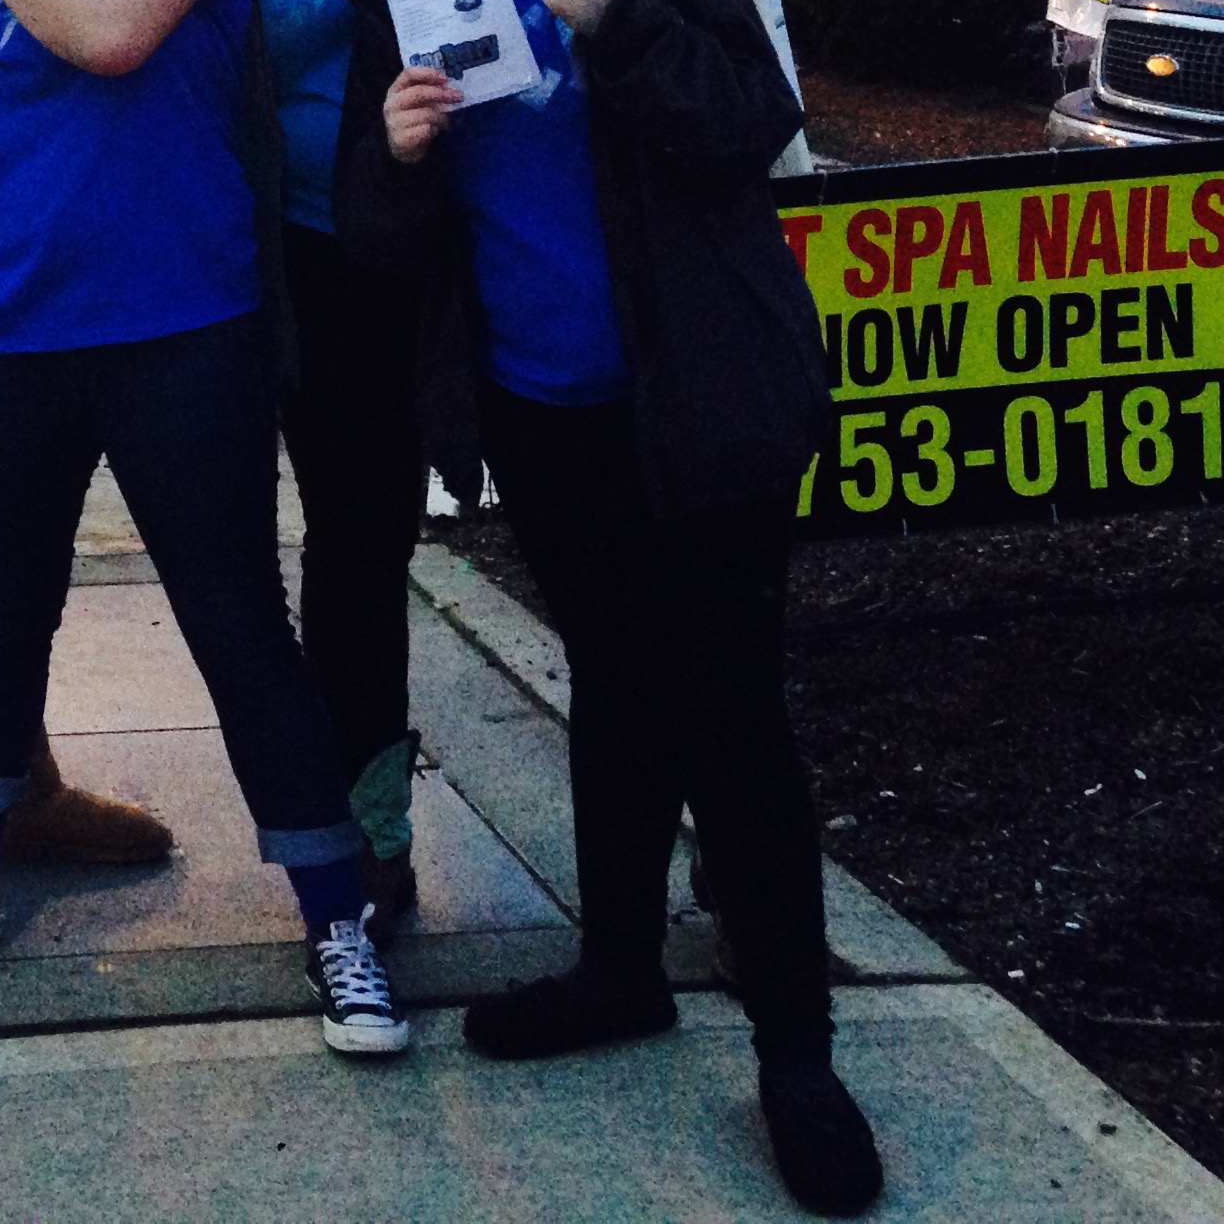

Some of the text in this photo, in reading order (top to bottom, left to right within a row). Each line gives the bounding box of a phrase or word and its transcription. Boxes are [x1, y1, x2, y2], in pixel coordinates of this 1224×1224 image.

[843, 200, 992, 299] SPA
[1017, 176, 1224, 282] NAILS
[996, 282, 1195, 374] OPEN
